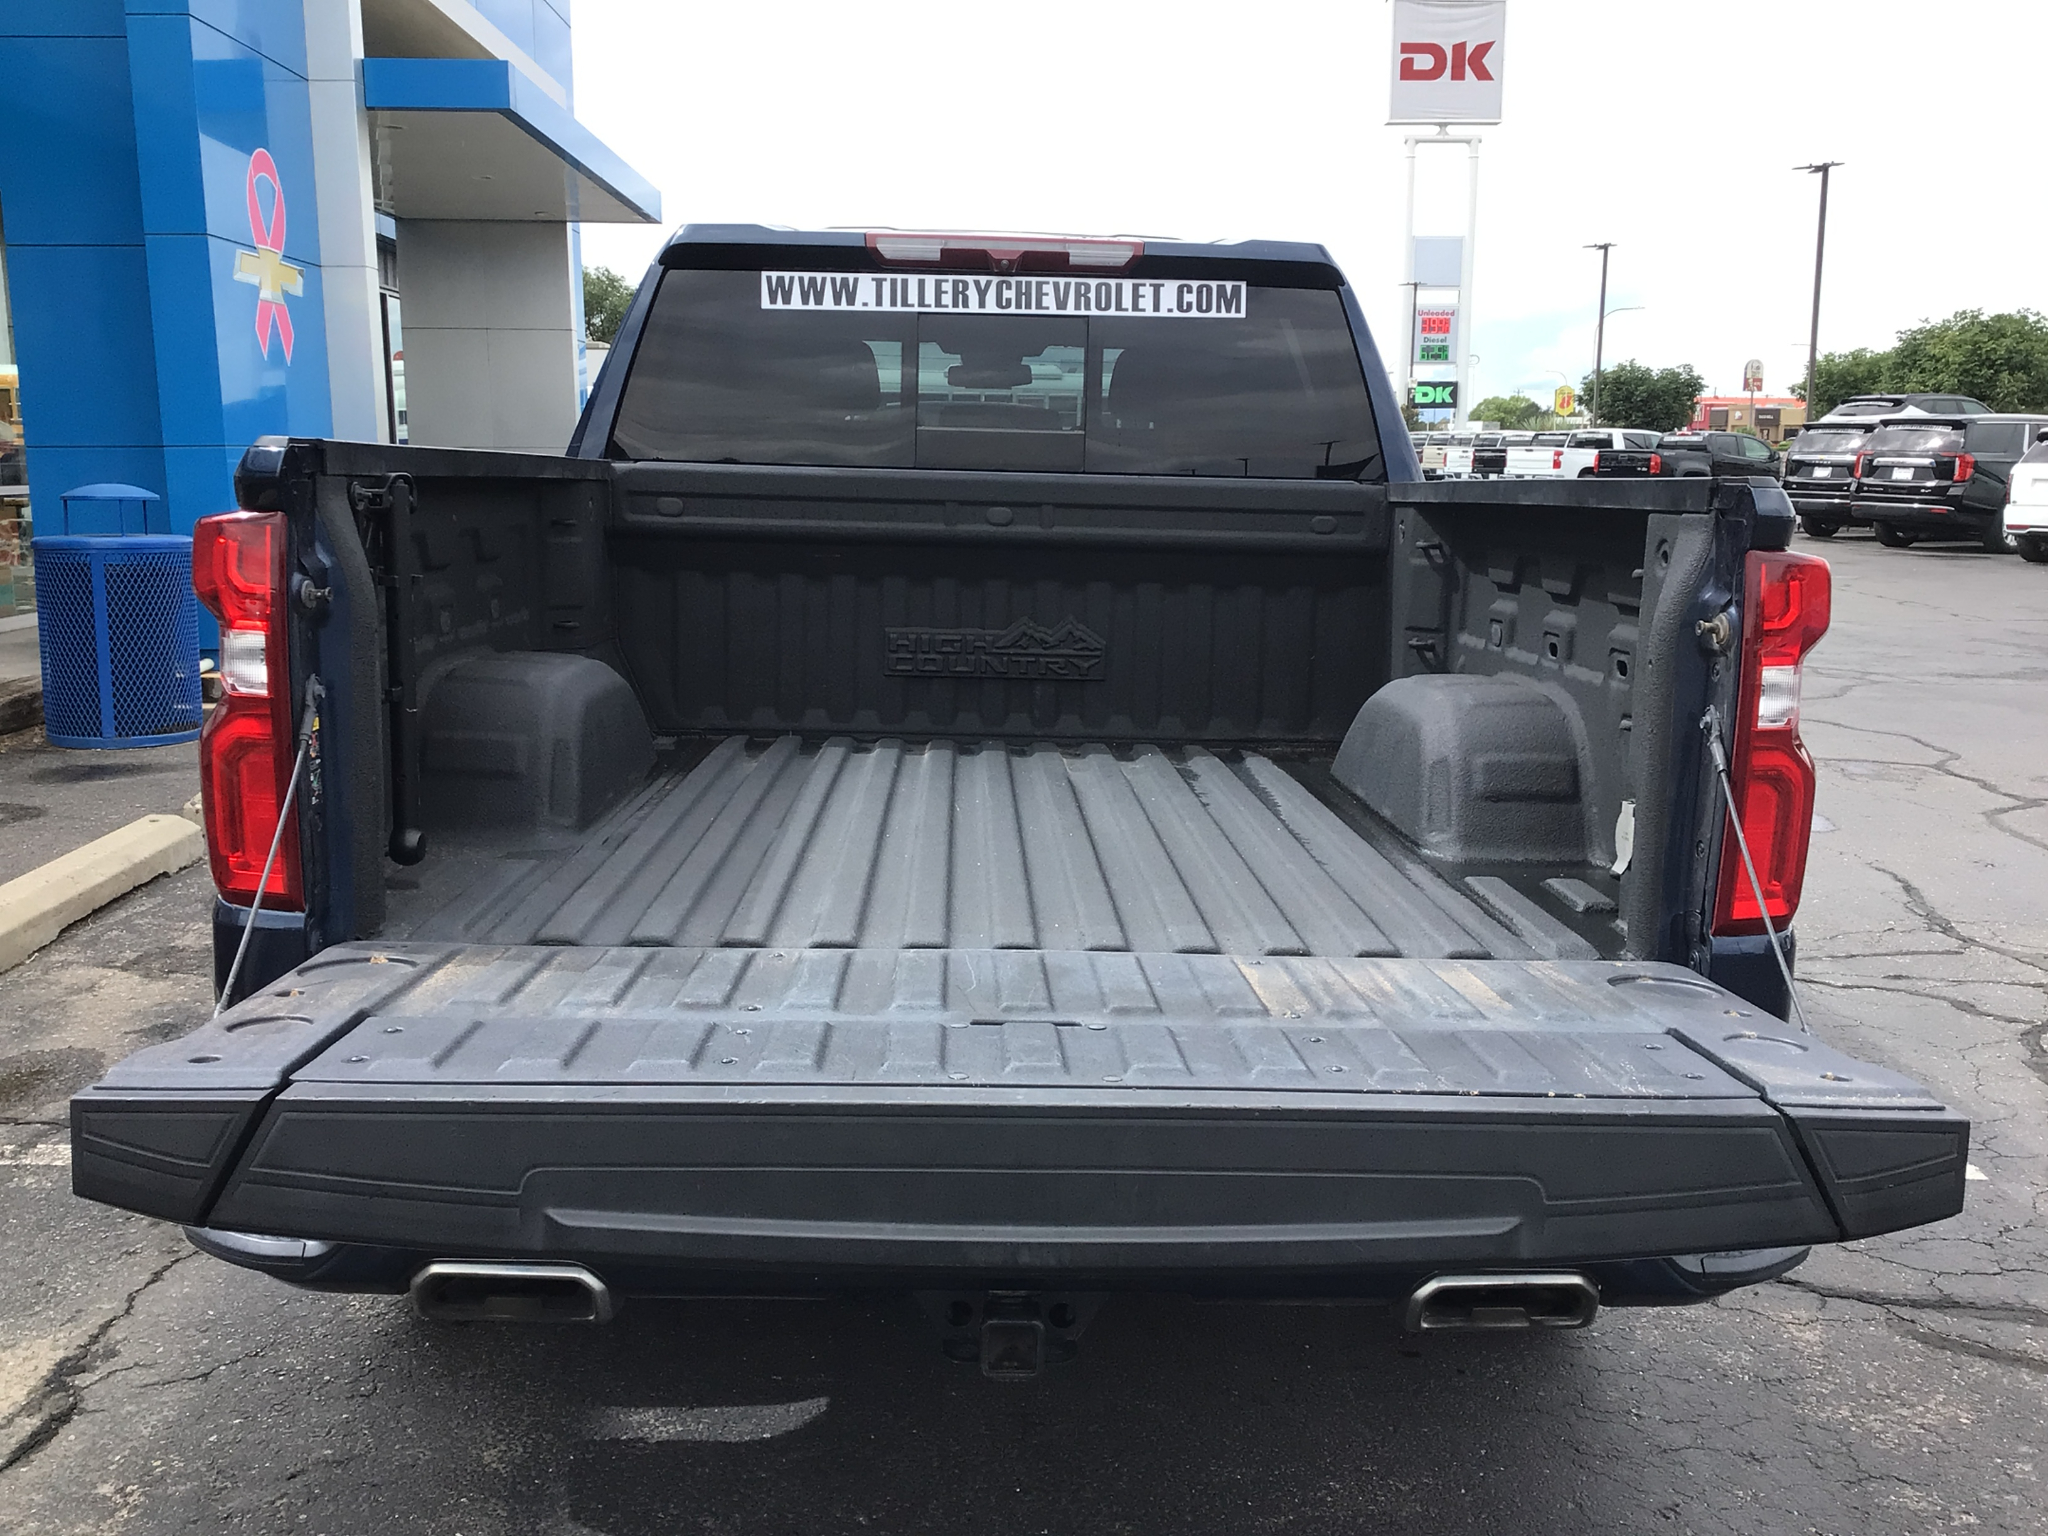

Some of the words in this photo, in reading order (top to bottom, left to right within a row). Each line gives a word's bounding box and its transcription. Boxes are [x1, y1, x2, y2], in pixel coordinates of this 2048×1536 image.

[1400, 41, 1496, 81] DK
[765, 275, 1242, 314] WWW.TILLERYCHEVROLET.COM
[1414, 386, 1454, 403] DK
[888, 632, 995, 652] HIGH
[888, 653, 1101, 676] COUNTRY
